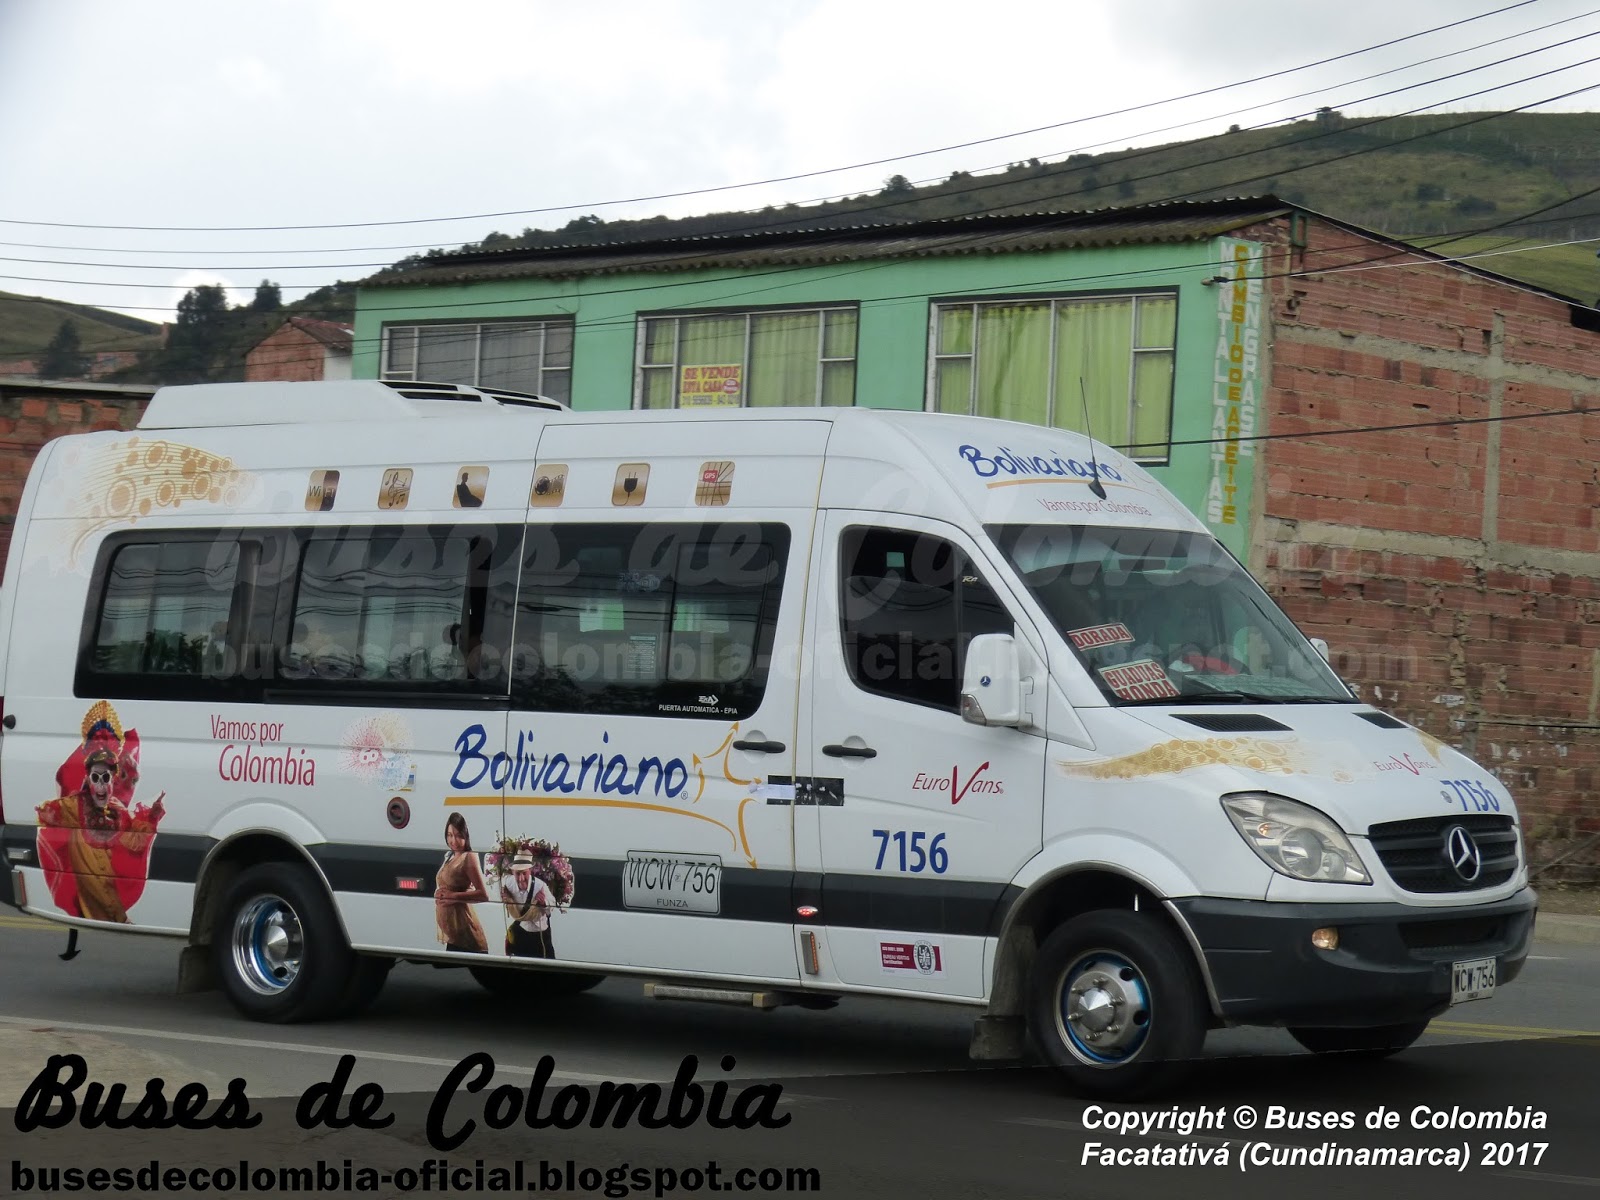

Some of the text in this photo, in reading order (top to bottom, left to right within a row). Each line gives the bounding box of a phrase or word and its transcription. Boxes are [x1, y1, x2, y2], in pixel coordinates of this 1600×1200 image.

[701, 366, 740, 379] VENDE
[1238, 279, 1262, 456] ENGRASE
[1222, 245, 1248, 525] CAMBIO DE ACEITE
[959, 444, 1122, 482] Bolivariano
[1036, 498, 1152, 516] Vamos por Colombia
[1070, 626, 1130, 647] DORADA
[1104, 662, 1167, 689] GUADUAS
[1115, 680, 1179, 700] HONDA
[658, 704, 681, 712] PUERTA
[682, 705, 719, 714] AUTOMATICA
[211, 714, 284, 747] Vamos por
[218, 744, 316, 786] Colombia
[450, 724, 688, 798] Bolivariano
[1373, 752, 1431, 776] EuroVans
[912, 761, 1003, 805] EuroVans
[1440, 780, 1500, 812] 7156
[873, 829, 948, 874] 7156
[656, 898, 688, 907] FUNZA
